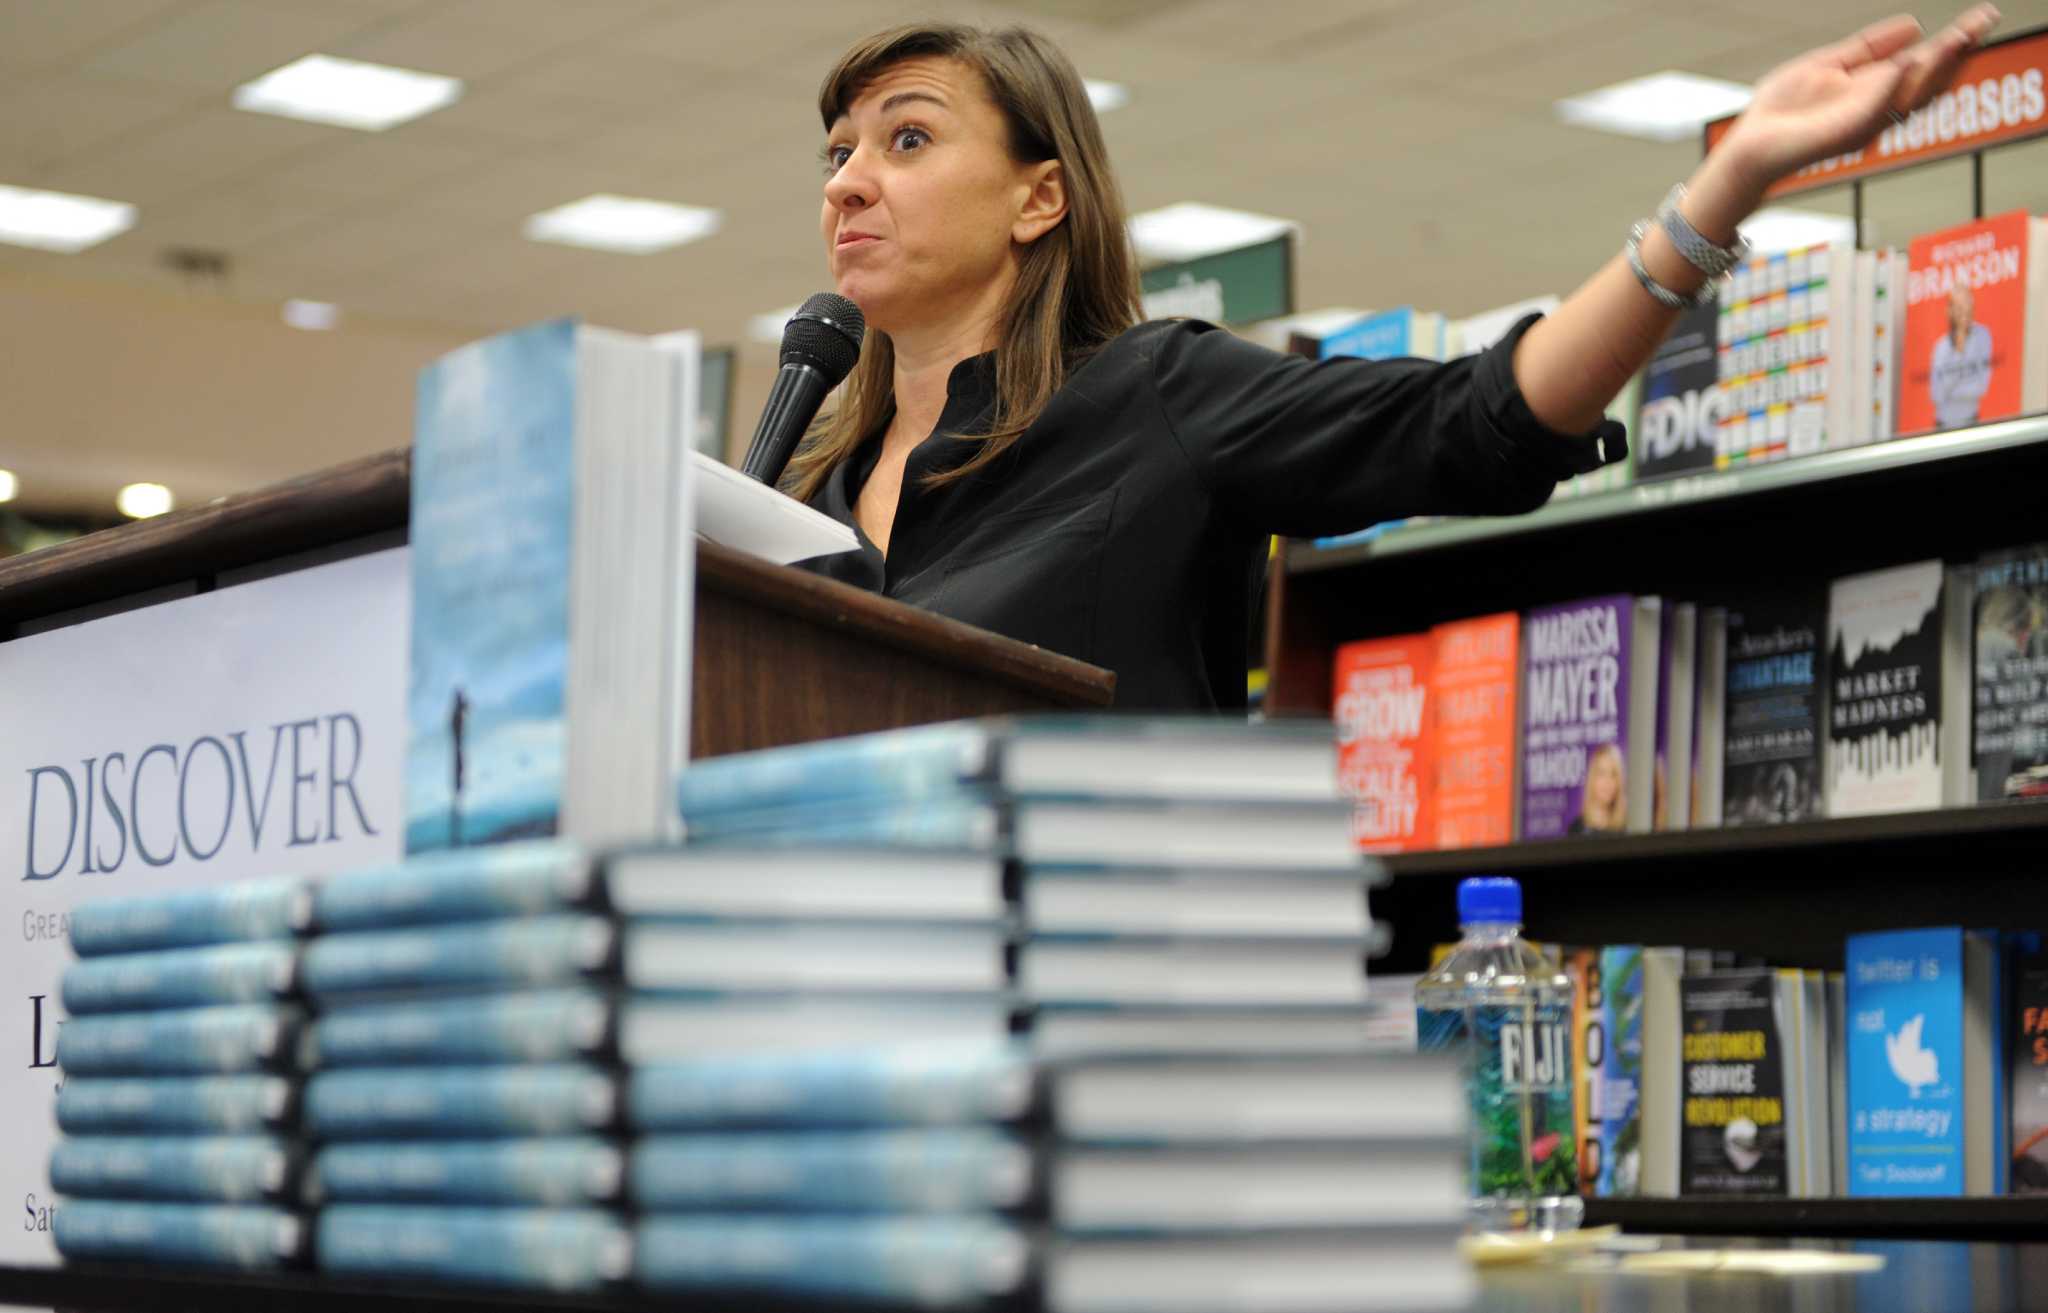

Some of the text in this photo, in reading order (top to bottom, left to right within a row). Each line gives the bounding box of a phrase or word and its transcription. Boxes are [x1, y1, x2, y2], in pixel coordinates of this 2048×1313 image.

[1907, 245, 2021, 306] BRANSON
[1529, 605, 1621, 663] MARISSA
[1529, 655, 1620, 727] MAYER
[1837, 665, 1920, 700] MARKET
[1834, 693, 1926, 729] MADNESS
[21, 711, 380, 882] DISCOVER
[22, 908, 72, 942] GREA
[1857, 957, 1940, 982] twitter is
[1856, 1009, 1885, 1031] not
[1501, 1021, 1565, 1086] FIJI
[1685, 1031, 1766, 1062] CUSTOMER
[1689, 1064, 1756, 1094] SERVICE
[1686, 1096, 1782, 1128] REVOLUTION
[1871, 1106, 1952, 1137] strategy
